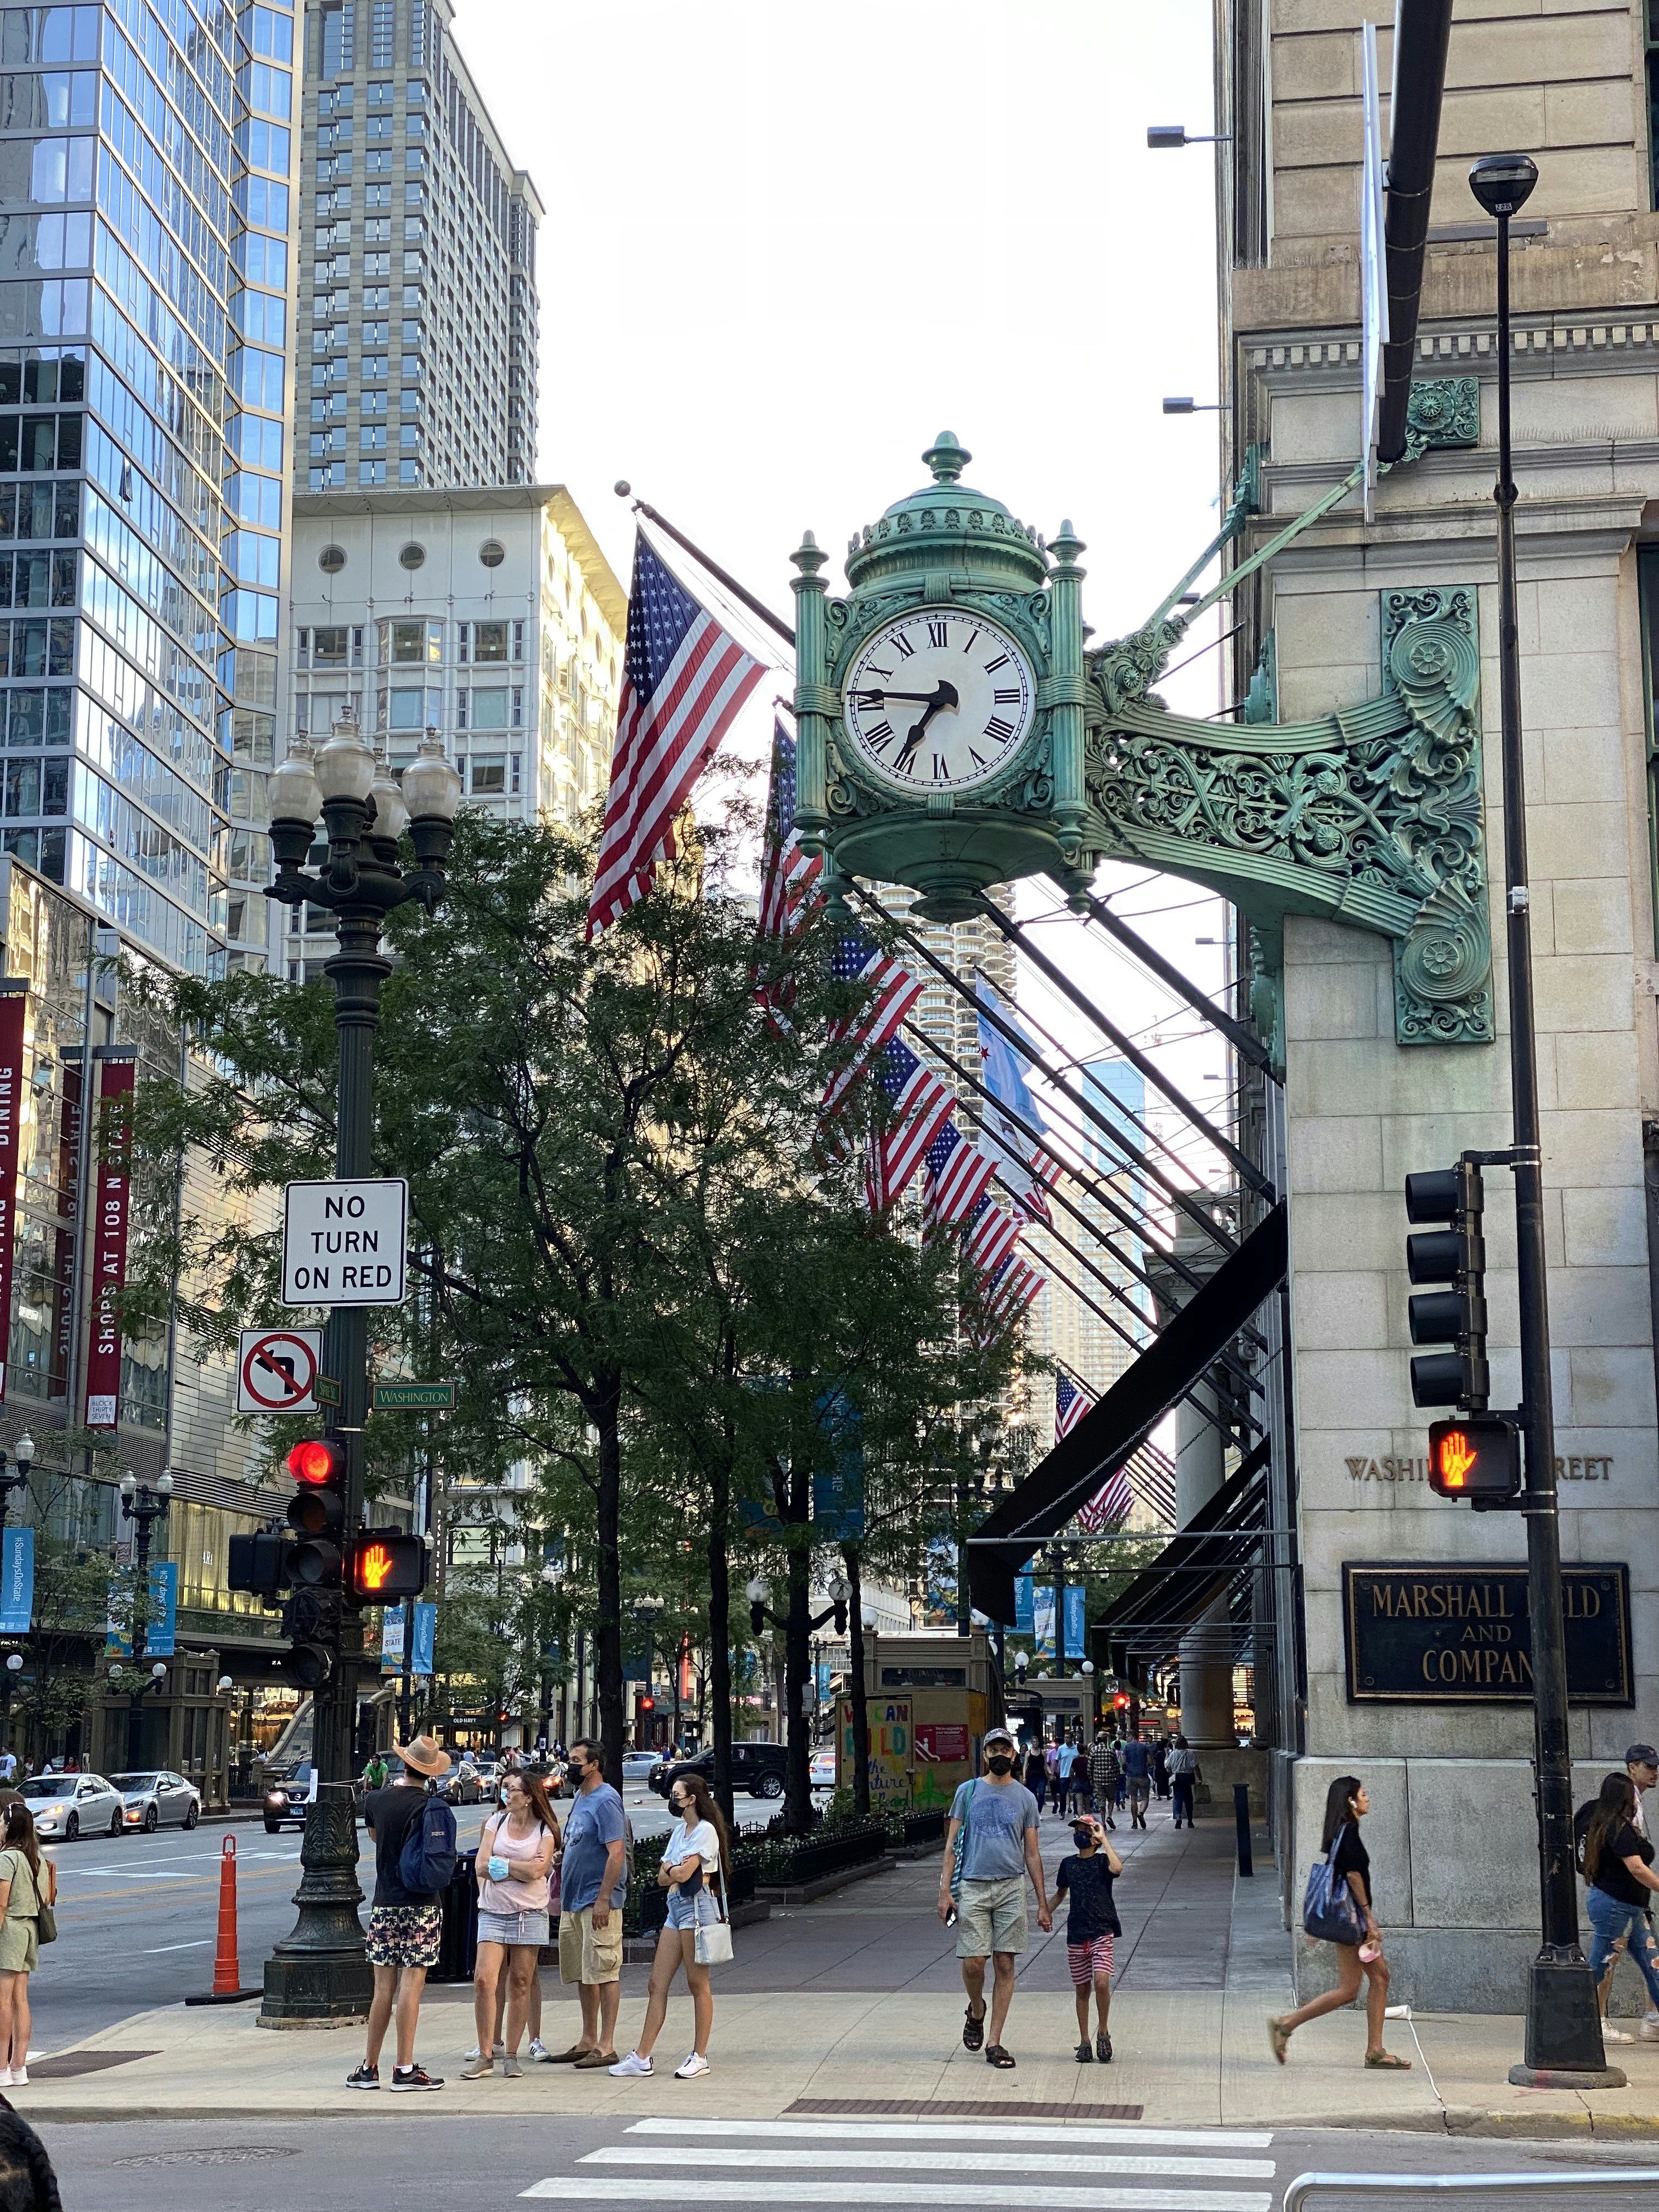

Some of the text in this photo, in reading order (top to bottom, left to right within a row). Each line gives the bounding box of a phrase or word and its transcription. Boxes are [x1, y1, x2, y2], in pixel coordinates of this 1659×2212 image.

[926, 622, 949, 648] XII
[106, 1177, 122, 1189] N
[325, 1195, 365, 1218] NO
[104, 1200, 121, 1238] 108
[311, 1230, 378, 1254] TURN
[103, 1251, 119, 1274] AT
[295, 1265, 392, 1290] ON RED
[97, 1286, 118, 1355] SHOPS
[380, 1390, 448, 1403] WASHINGTON
[1345, 1455, 1613, 1482] WASHI REET
[13, 1537, 24, 1602] #SundaysOnState
[1372, 1585, 1515, 1617] MARSHALL
[385, 1638, 402, 1646] STATE
[1460, 1625, 1512, 1642] AND
[1423, 1650, 1534, 1683] COMPAN
[873, 1705, 908, 1722] CAN
